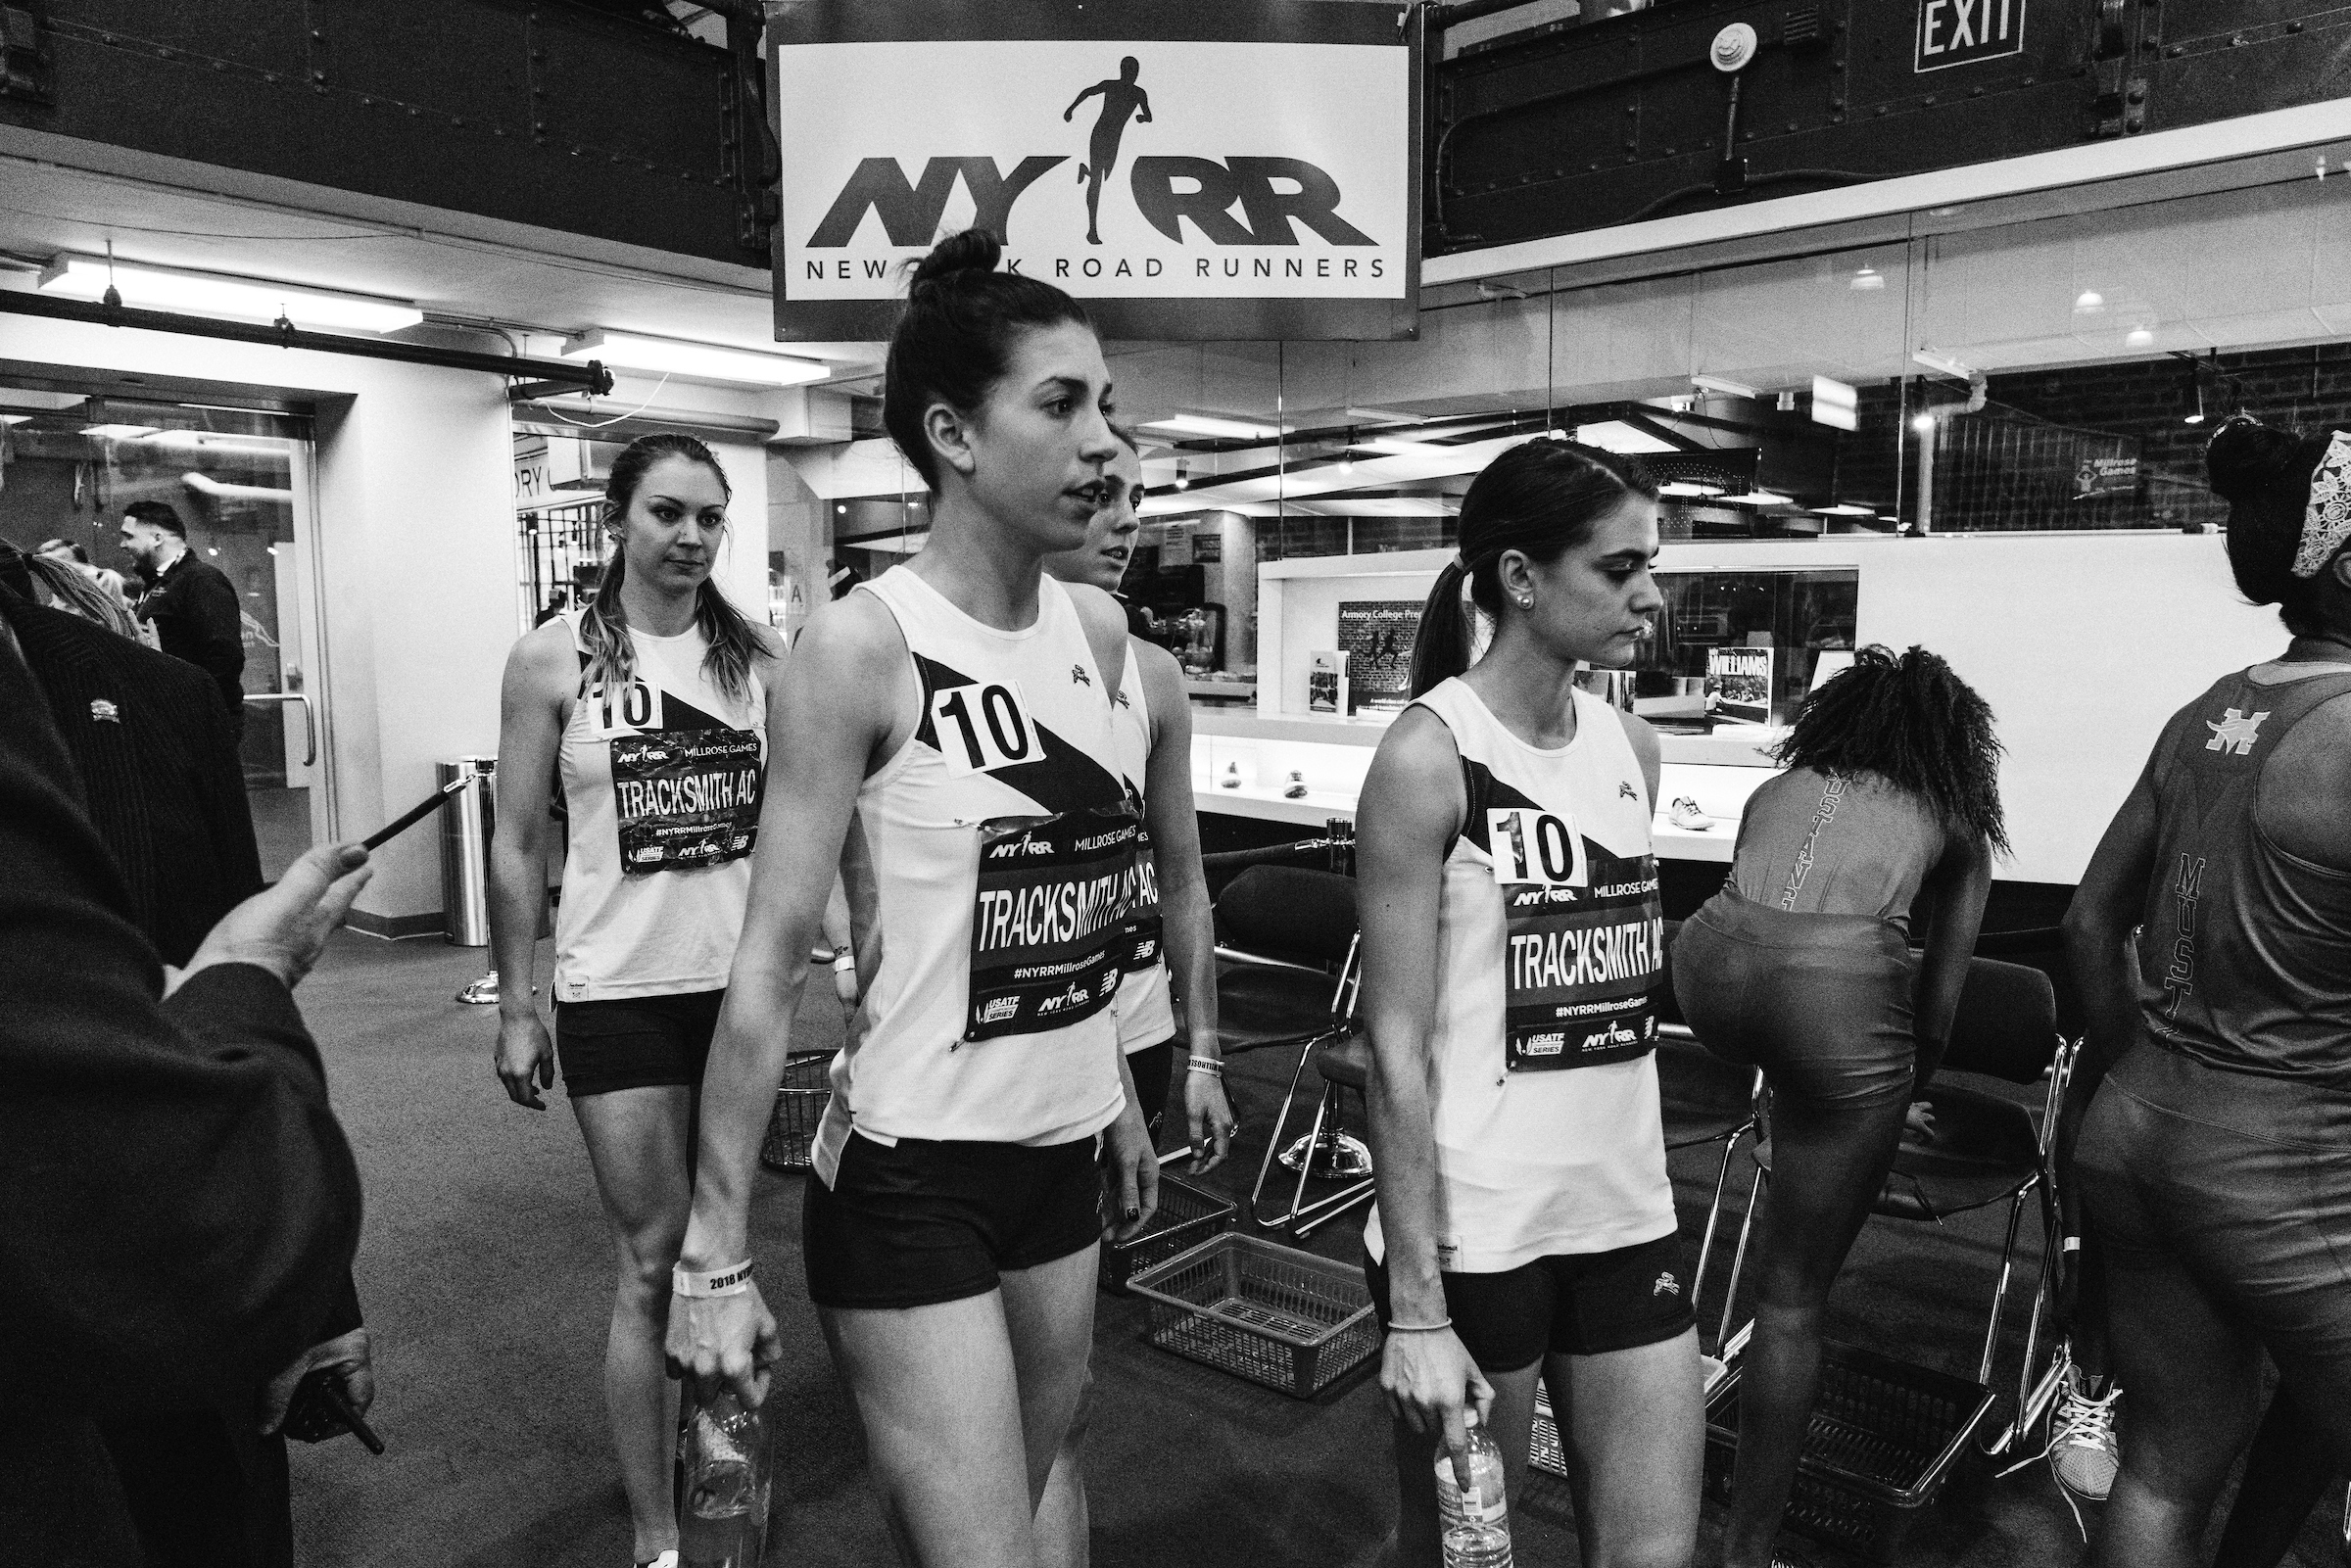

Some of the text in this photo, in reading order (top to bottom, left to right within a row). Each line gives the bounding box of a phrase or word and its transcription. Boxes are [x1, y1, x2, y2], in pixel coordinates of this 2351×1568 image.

[806, 258, 1384, 279] NEW ROAD RUNNERS
[1341, 609, 1371, 620] Armory
[1372, 609, 1403, 620] College
[1708, 654, 1768, 677] WILLIAMS
[593, 683, 651, 729] 10
[938, 684, 1029, 770] 10
[685, 745, 727, 757] MILLROSE
[729, 742, 757, 754] GAMES
[617, 768, 756, 819] TRACKSMITH AC
[988, 825, 1136, 859] NYRR MILLROSE GAMES
[1496, 811, 1574, 882] 10
[1138, 862, 1158, 907] AC
[1513, 888, 1578, 907] NYRR
[1594, 882, 1641, 898] MILLROSE
[979, 873, 1119, 952] TRACKSMITH
[2164, 852, 2206, 1021] MUST
[1014, 950, 1105, 979] #NYRRMillroseGames
[1511, 920, 1650, 990] TRACKSMITH
[988, 995, 1021, 1009] USATF
[1531, 1032, 1565, 1043] USATF
[1533, 1045, 1559, 1054] SERIES
[710, 1273, 736, 1290] 2018
